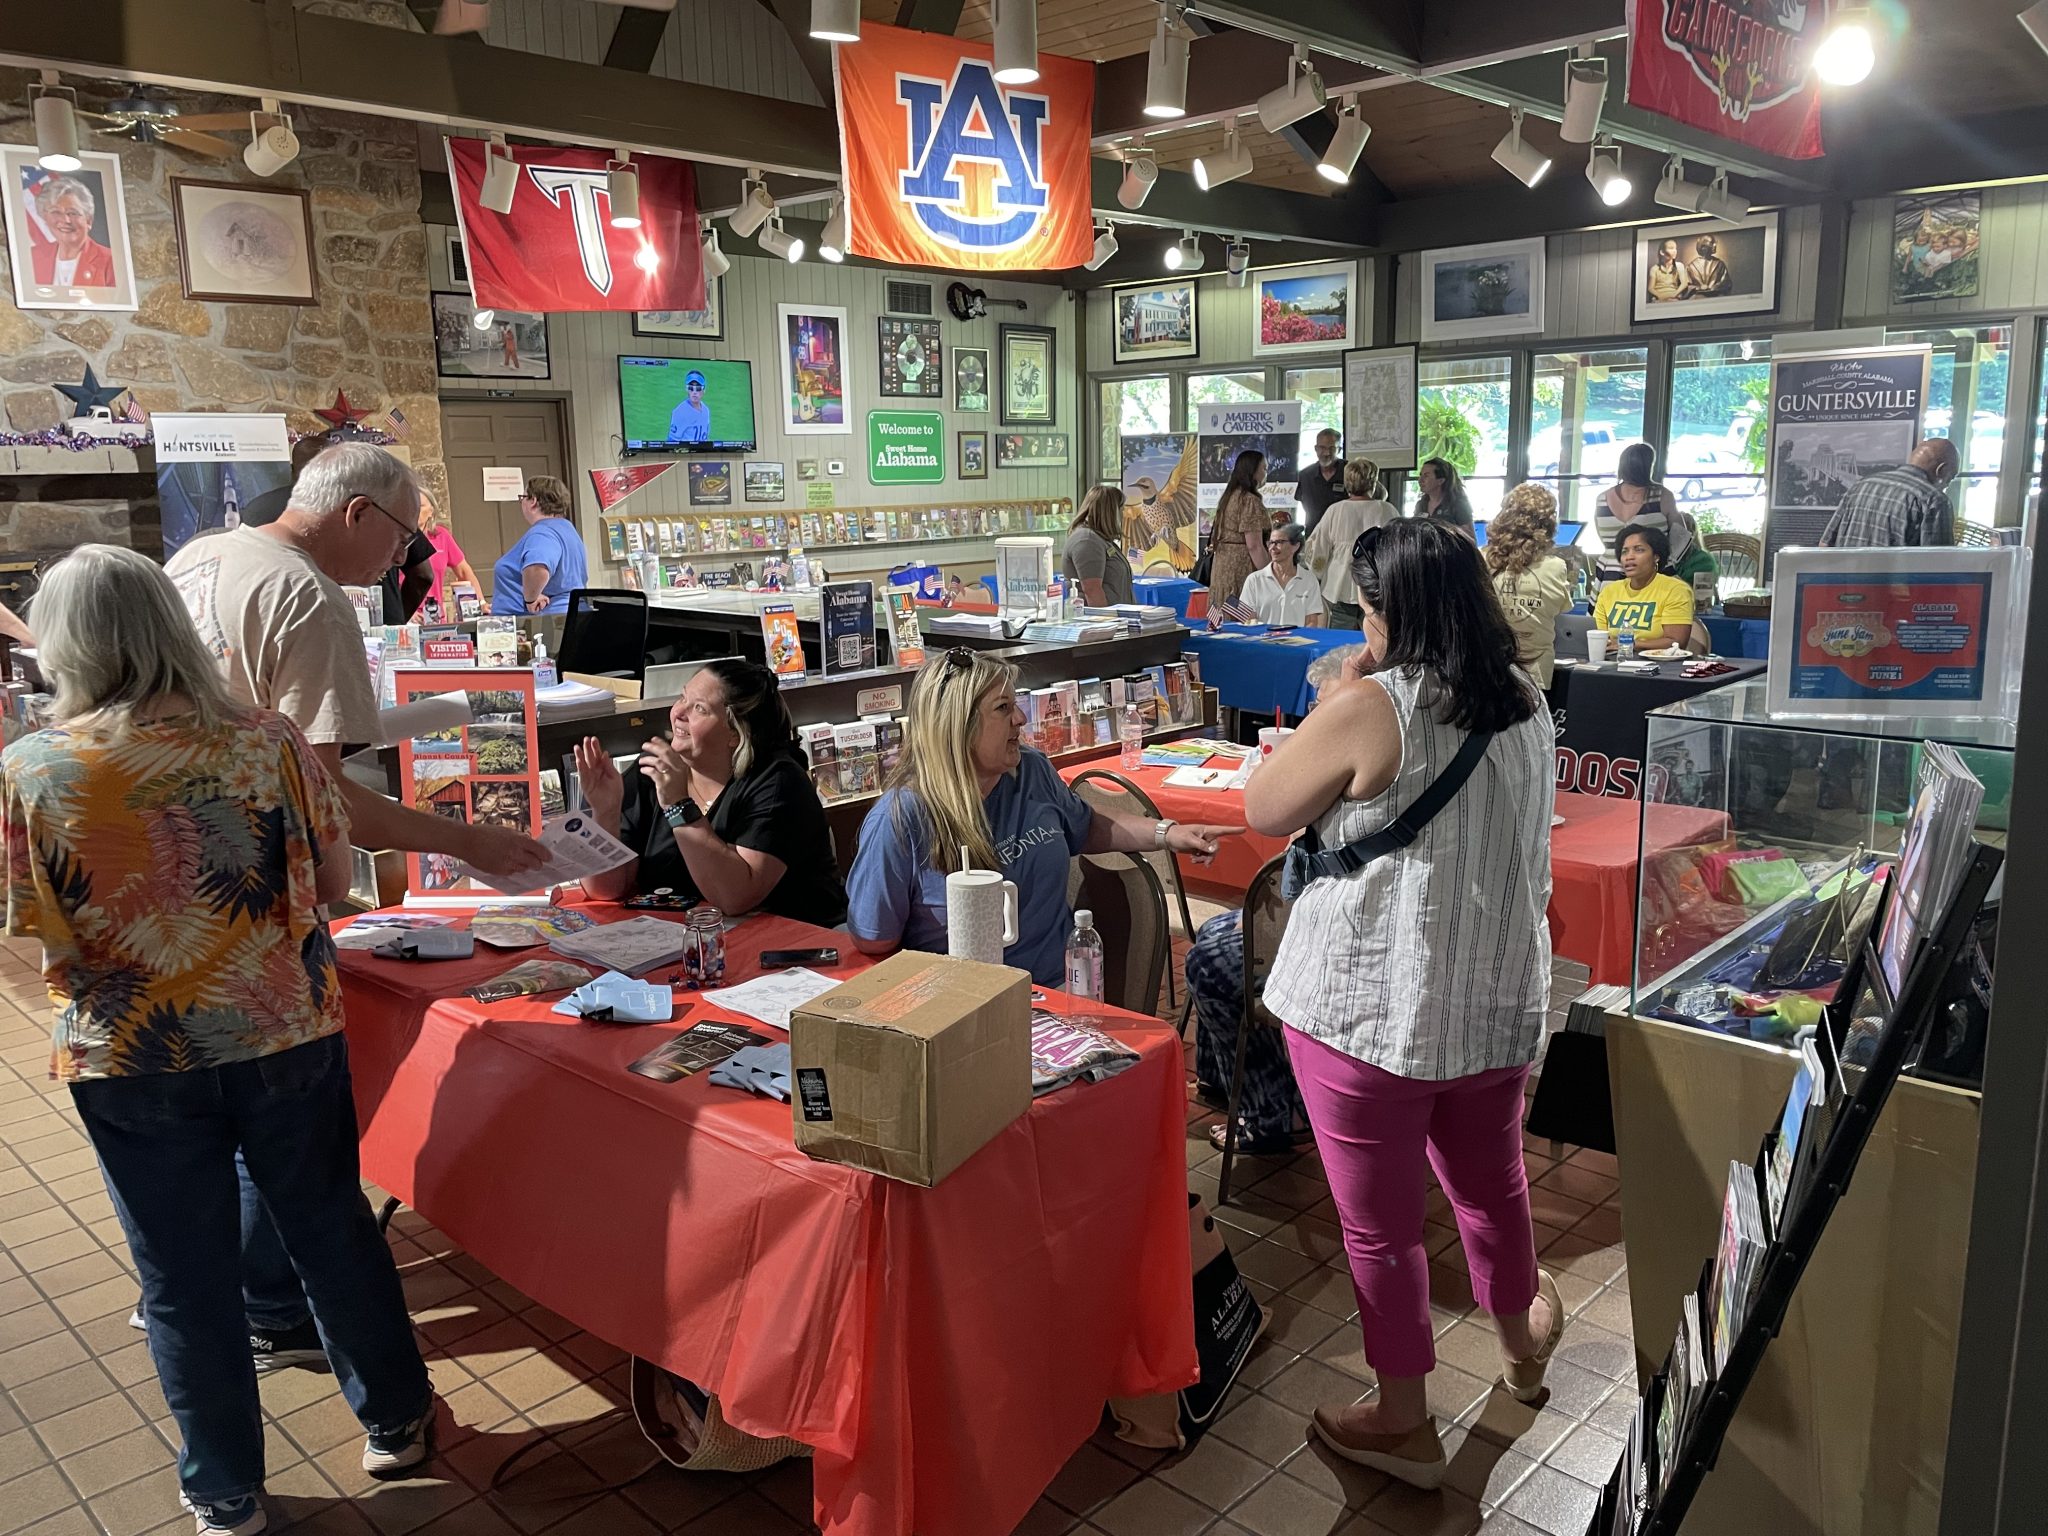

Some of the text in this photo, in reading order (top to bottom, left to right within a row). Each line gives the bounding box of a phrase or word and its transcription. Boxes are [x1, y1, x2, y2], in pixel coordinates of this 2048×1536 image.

[1863, 373, 1894, 385] ALABAMA
[1777, 389, 1916, 413] GUNTERSVILLE
[1225, 412, 1272, 421] MAJESTIC
[878, 423, 934, 435] Welcome to
[1222, 421, 1274, 433] CAVERNS
[876, 452, 938, 466] Alabama
[830, 595, 867, 606] Alabama
[1513, 598, 1541, 607] TOWN
[1912, 603, 1958, 613] ALABAMA
[1612, 603, 1649, 628] TCL
[1823, 625, 1874, 642] June Jam
[430, 644, 468, 652] VISITOR
[1869, 672, 1896, 680] JUNE
[872, 692, 886, 700] NO
[864, 699, 895, 711] SMOKING
[840, 731, 872, 743] TUSCALOOSA
[1211, 1279, 1246, 1332] ALABA
